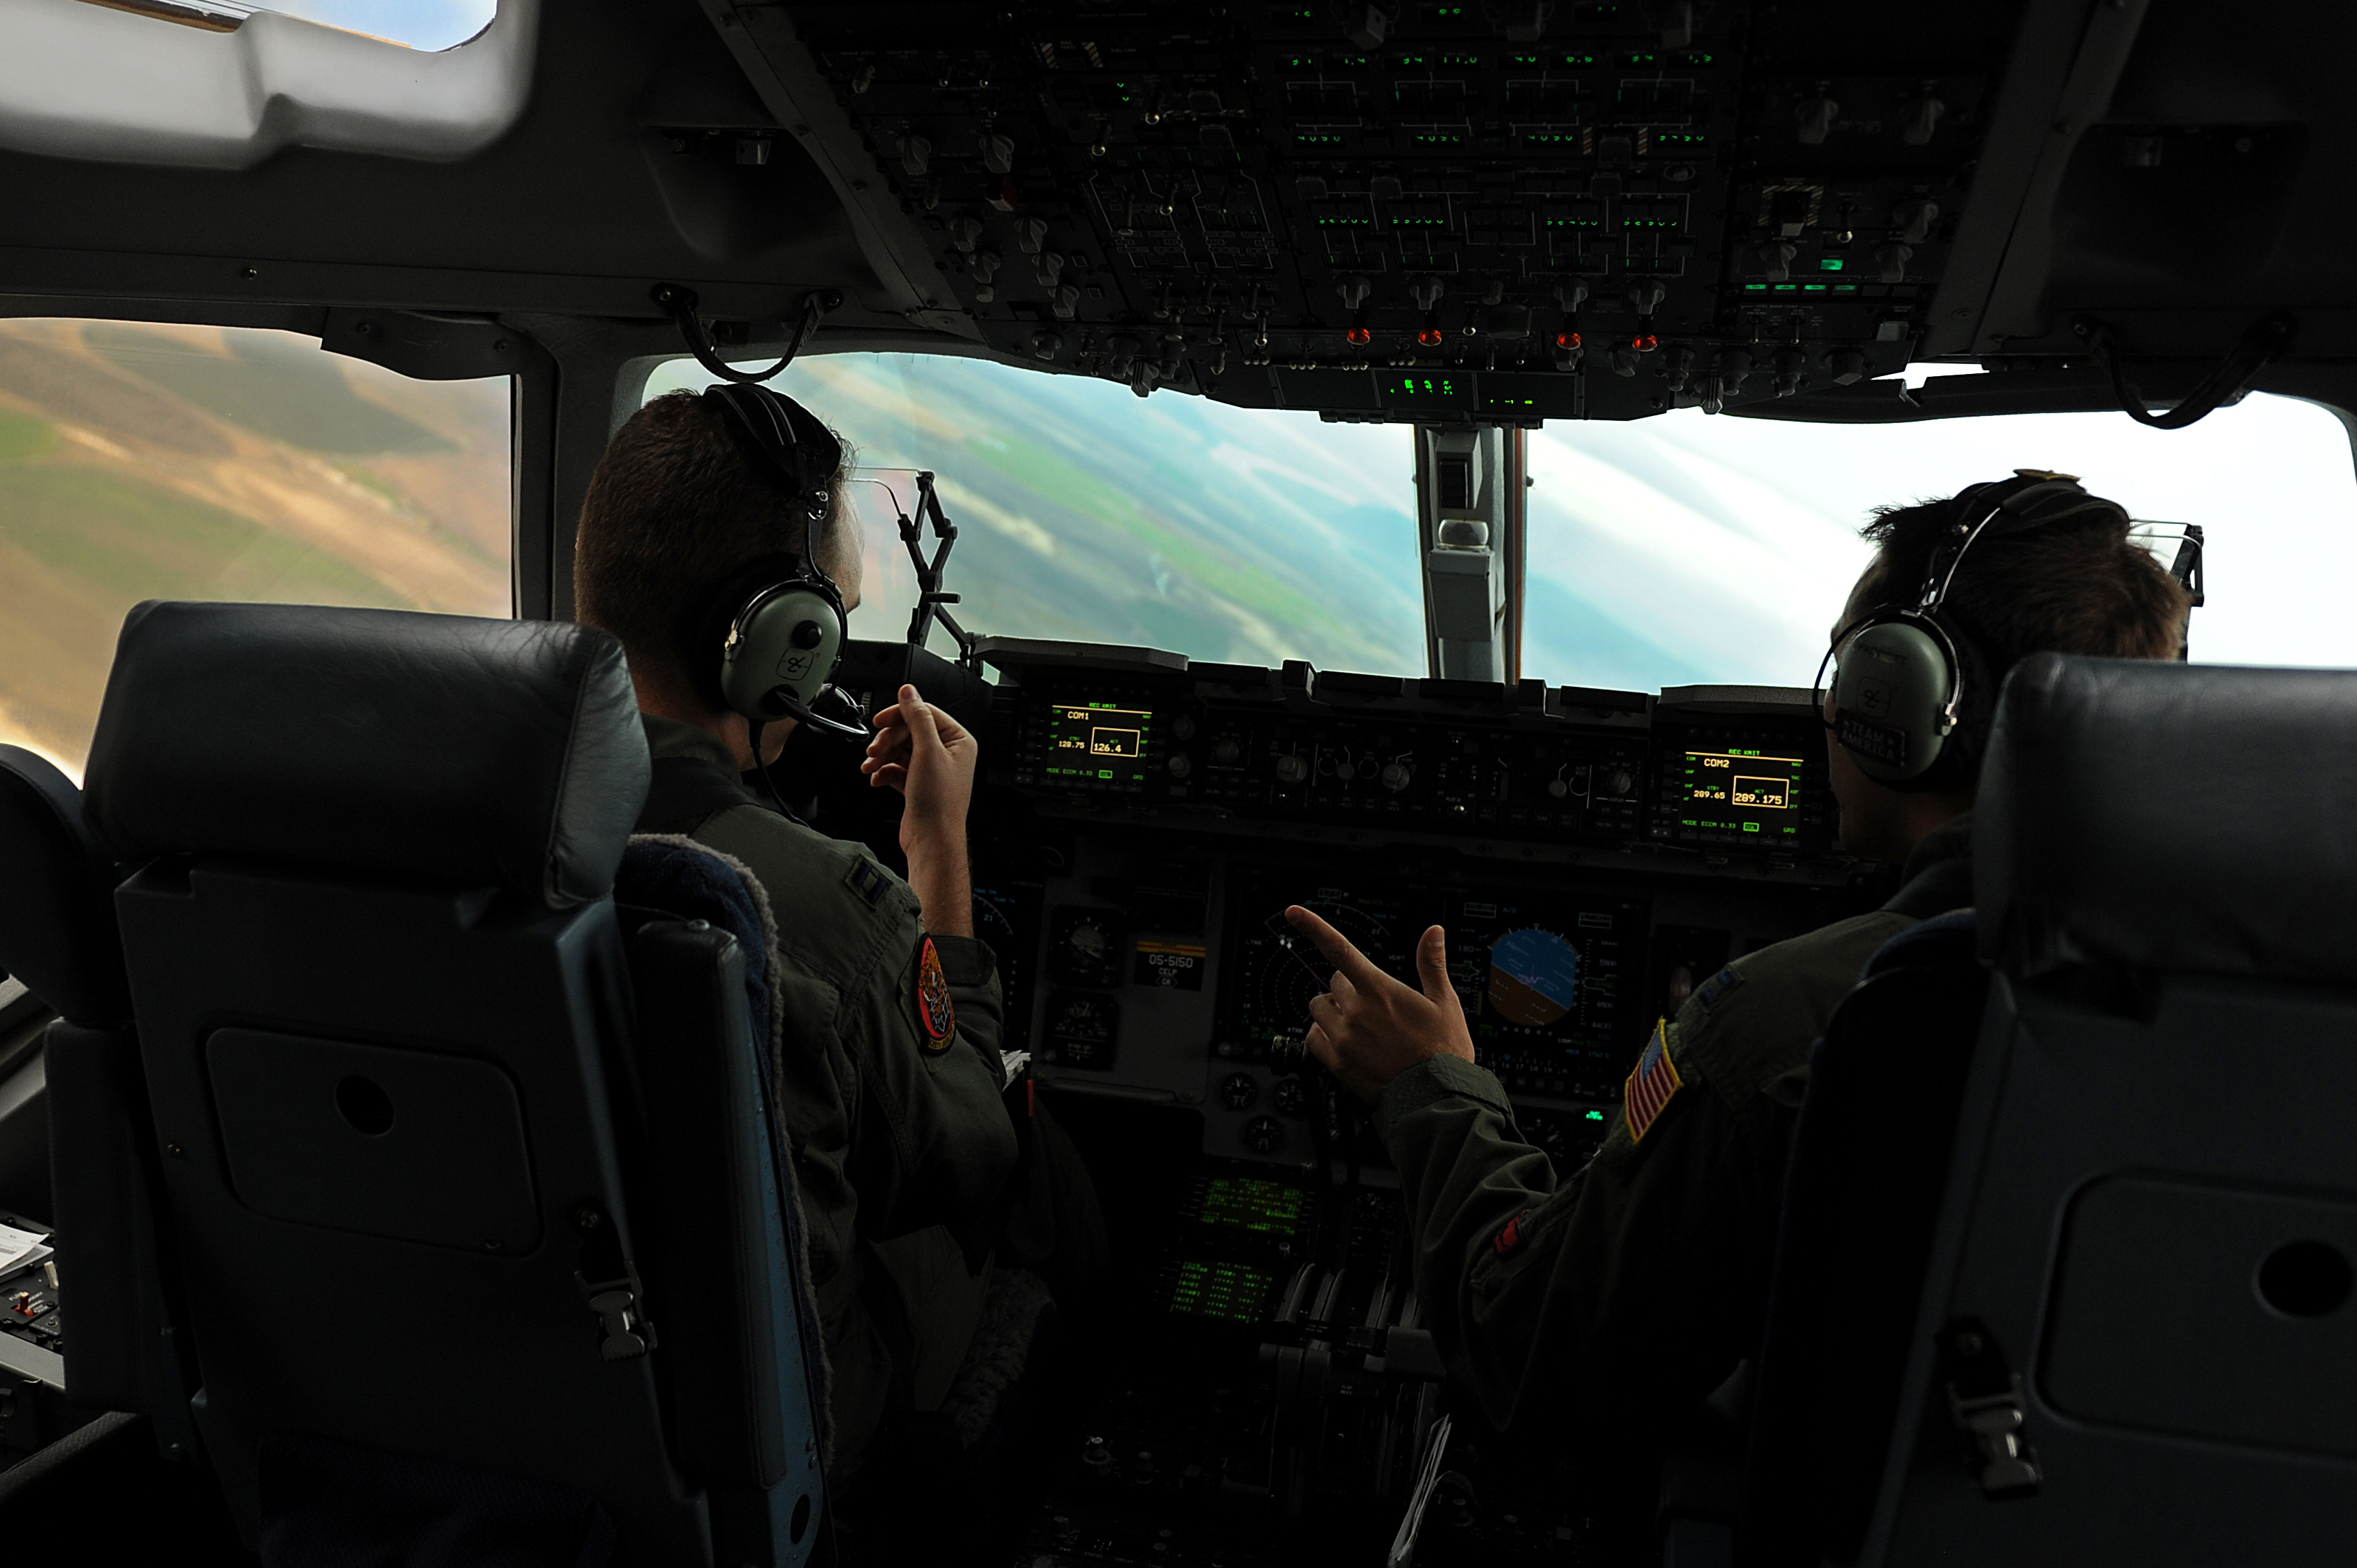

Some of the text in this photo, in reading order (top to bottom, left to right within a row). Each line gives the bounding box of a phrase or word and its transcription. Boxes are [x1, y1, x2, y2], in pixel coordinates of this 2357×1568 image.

[1067, 711, 1089, 721] COM1
[1851, 721, 1885, 744] TEAM
[1058, 740, 1086, 749] 128.75
[1094, 743, 1122, 753] 126.4
[1841, 730, 1895, 760] AMERICA
[1704, 758, 1730, 768] COM2
[1693, 790, 1725, 800] 289.65
[1735, 793, 1782, 805] 289.175
[1149, 953, 1194, 969] 05-5150
[1158, 967, 1178, 976] CELP
